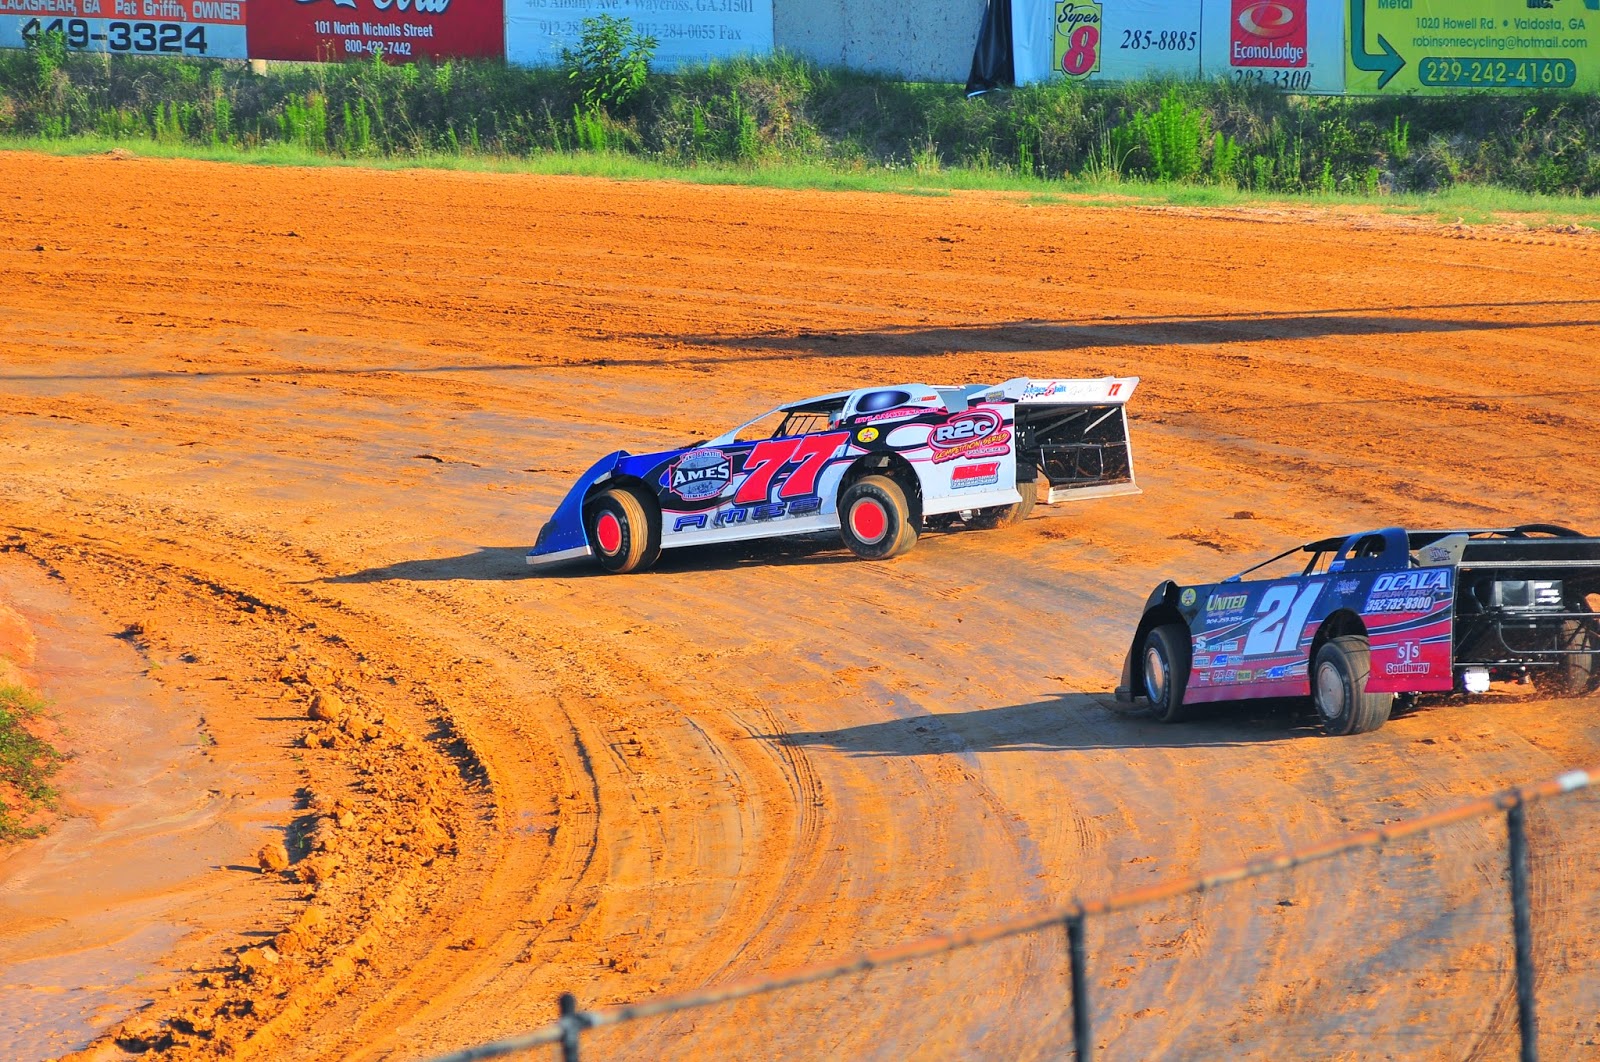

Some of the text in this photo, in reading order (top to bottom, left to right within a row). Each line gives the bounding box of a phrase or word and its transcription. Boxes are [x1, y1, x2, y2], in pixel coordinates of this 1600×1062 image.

[83, 0, 101, 14] GA
[114, 0, 137, 15] Pat
[143, 0, 187, 21] Griffin,
[192, 1, 240, 20] OWNER
[635, 0, 694, 14] Waycross,
[719, 0, 754, 13] 31501
[1058, 3, 1100, 33] Super
[314, 20, 434, 37] 101 North Nicholls Street
[719, 24, 742, 40] Fax
[1416, 17, 1586, 31] 1020 Howell Rd. Valdosta, GA
[22, 18, 207, 54] 449-3324
[344, 39, 412, 55] 800-422-7442
[1120, 29, 1198, 51] 285-8885
[1412, 35, 1588, 50] robinsonrecycling@hotmail.com
[1062, 25, 1099, 75] 8
[1233, 41, 1304, 63] EconoLodge
[1427, 61, 1567, 83] 229-242-4160
[936, 419, 992, 442] R2C
[934, 441, 981, 460] COMPETITION
[672, 462, 730, 488] AMES
[732, 431, 850, 504] 77
[673, 498, 824, 532] AMES
[1373, 571, 1448, 592] OCALA
[1242, 581, 1326, 656] 21
[1386, 662, 1430, 675] Southway
